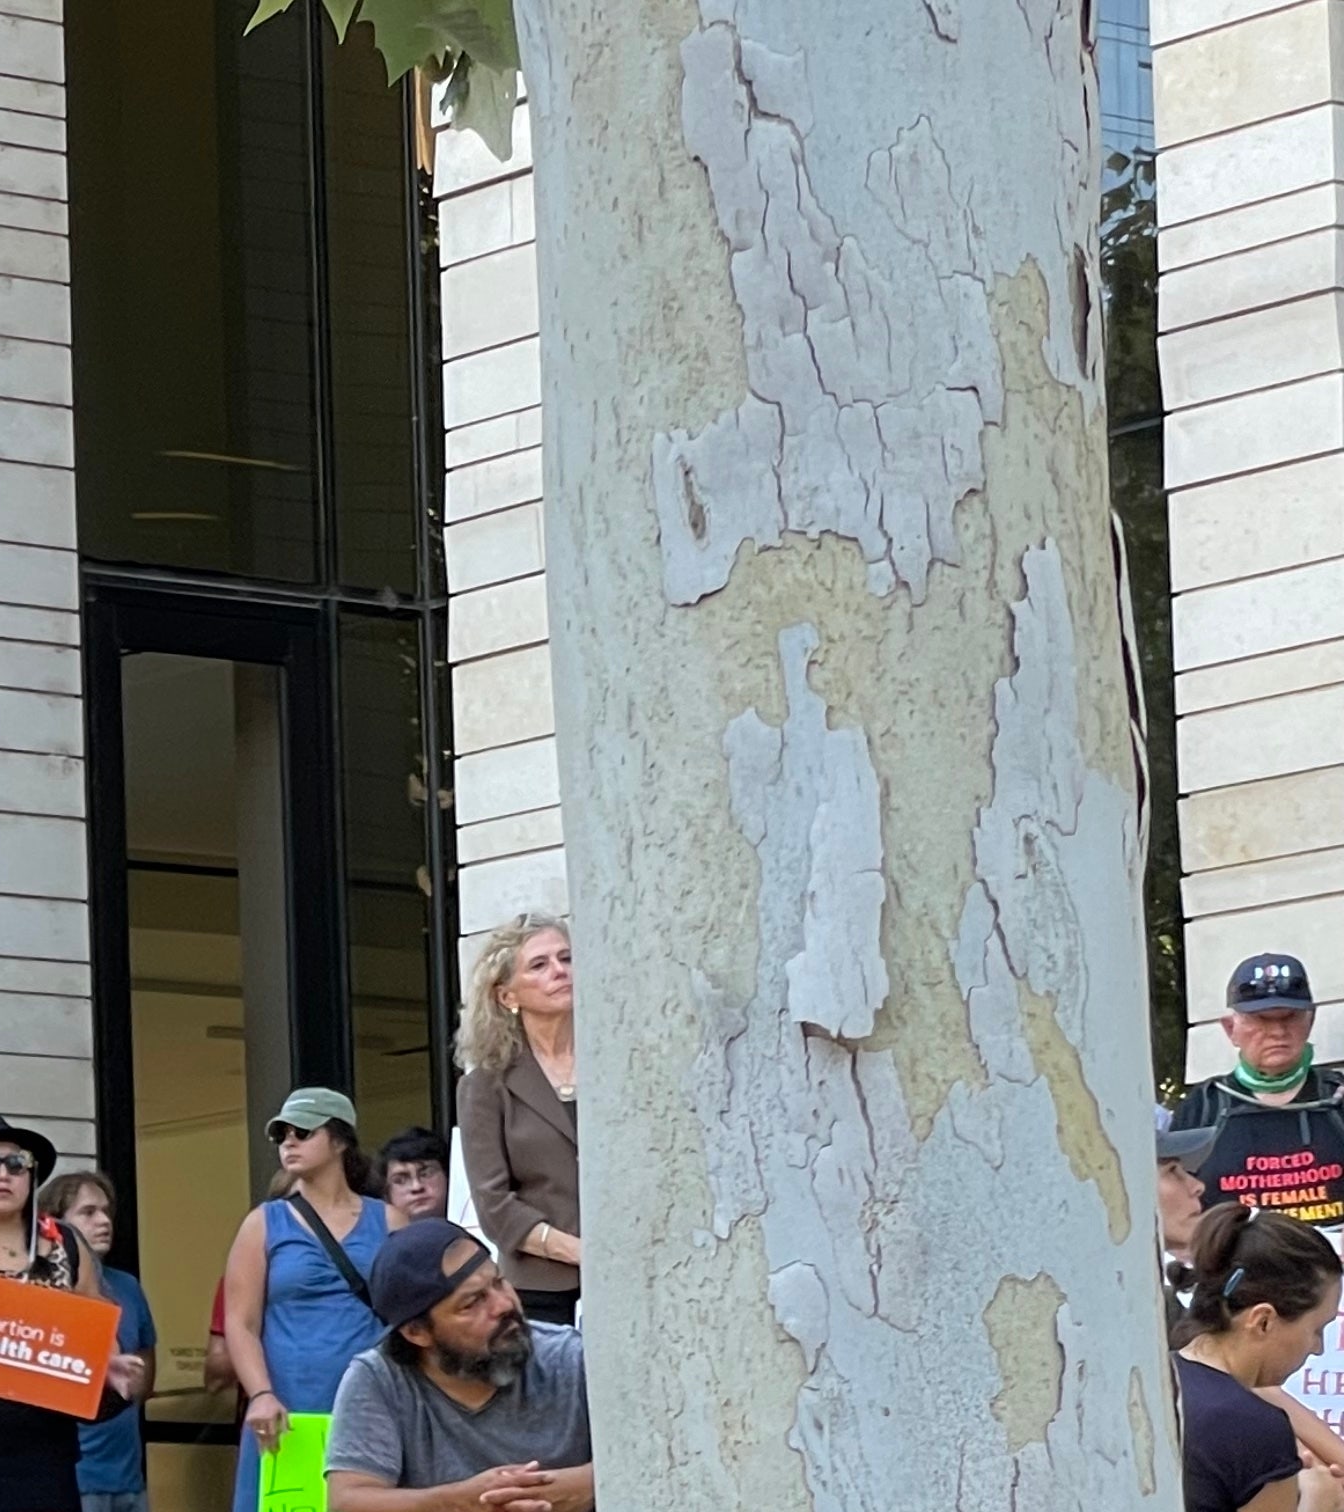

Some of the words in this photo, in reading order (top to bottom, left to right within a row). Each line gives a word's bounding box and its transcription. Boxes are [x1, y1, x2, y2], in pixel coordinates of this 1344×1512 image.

[1246, 1151, 1314, 1171] FORCED
[1220, 1164, 1343, 1191] MOTHERHOOD
[1261, 1186, 1328, 1206] FEMALE
[49, 1328, 64, 1347] is
[37, 1349, 92, 1376] care.
